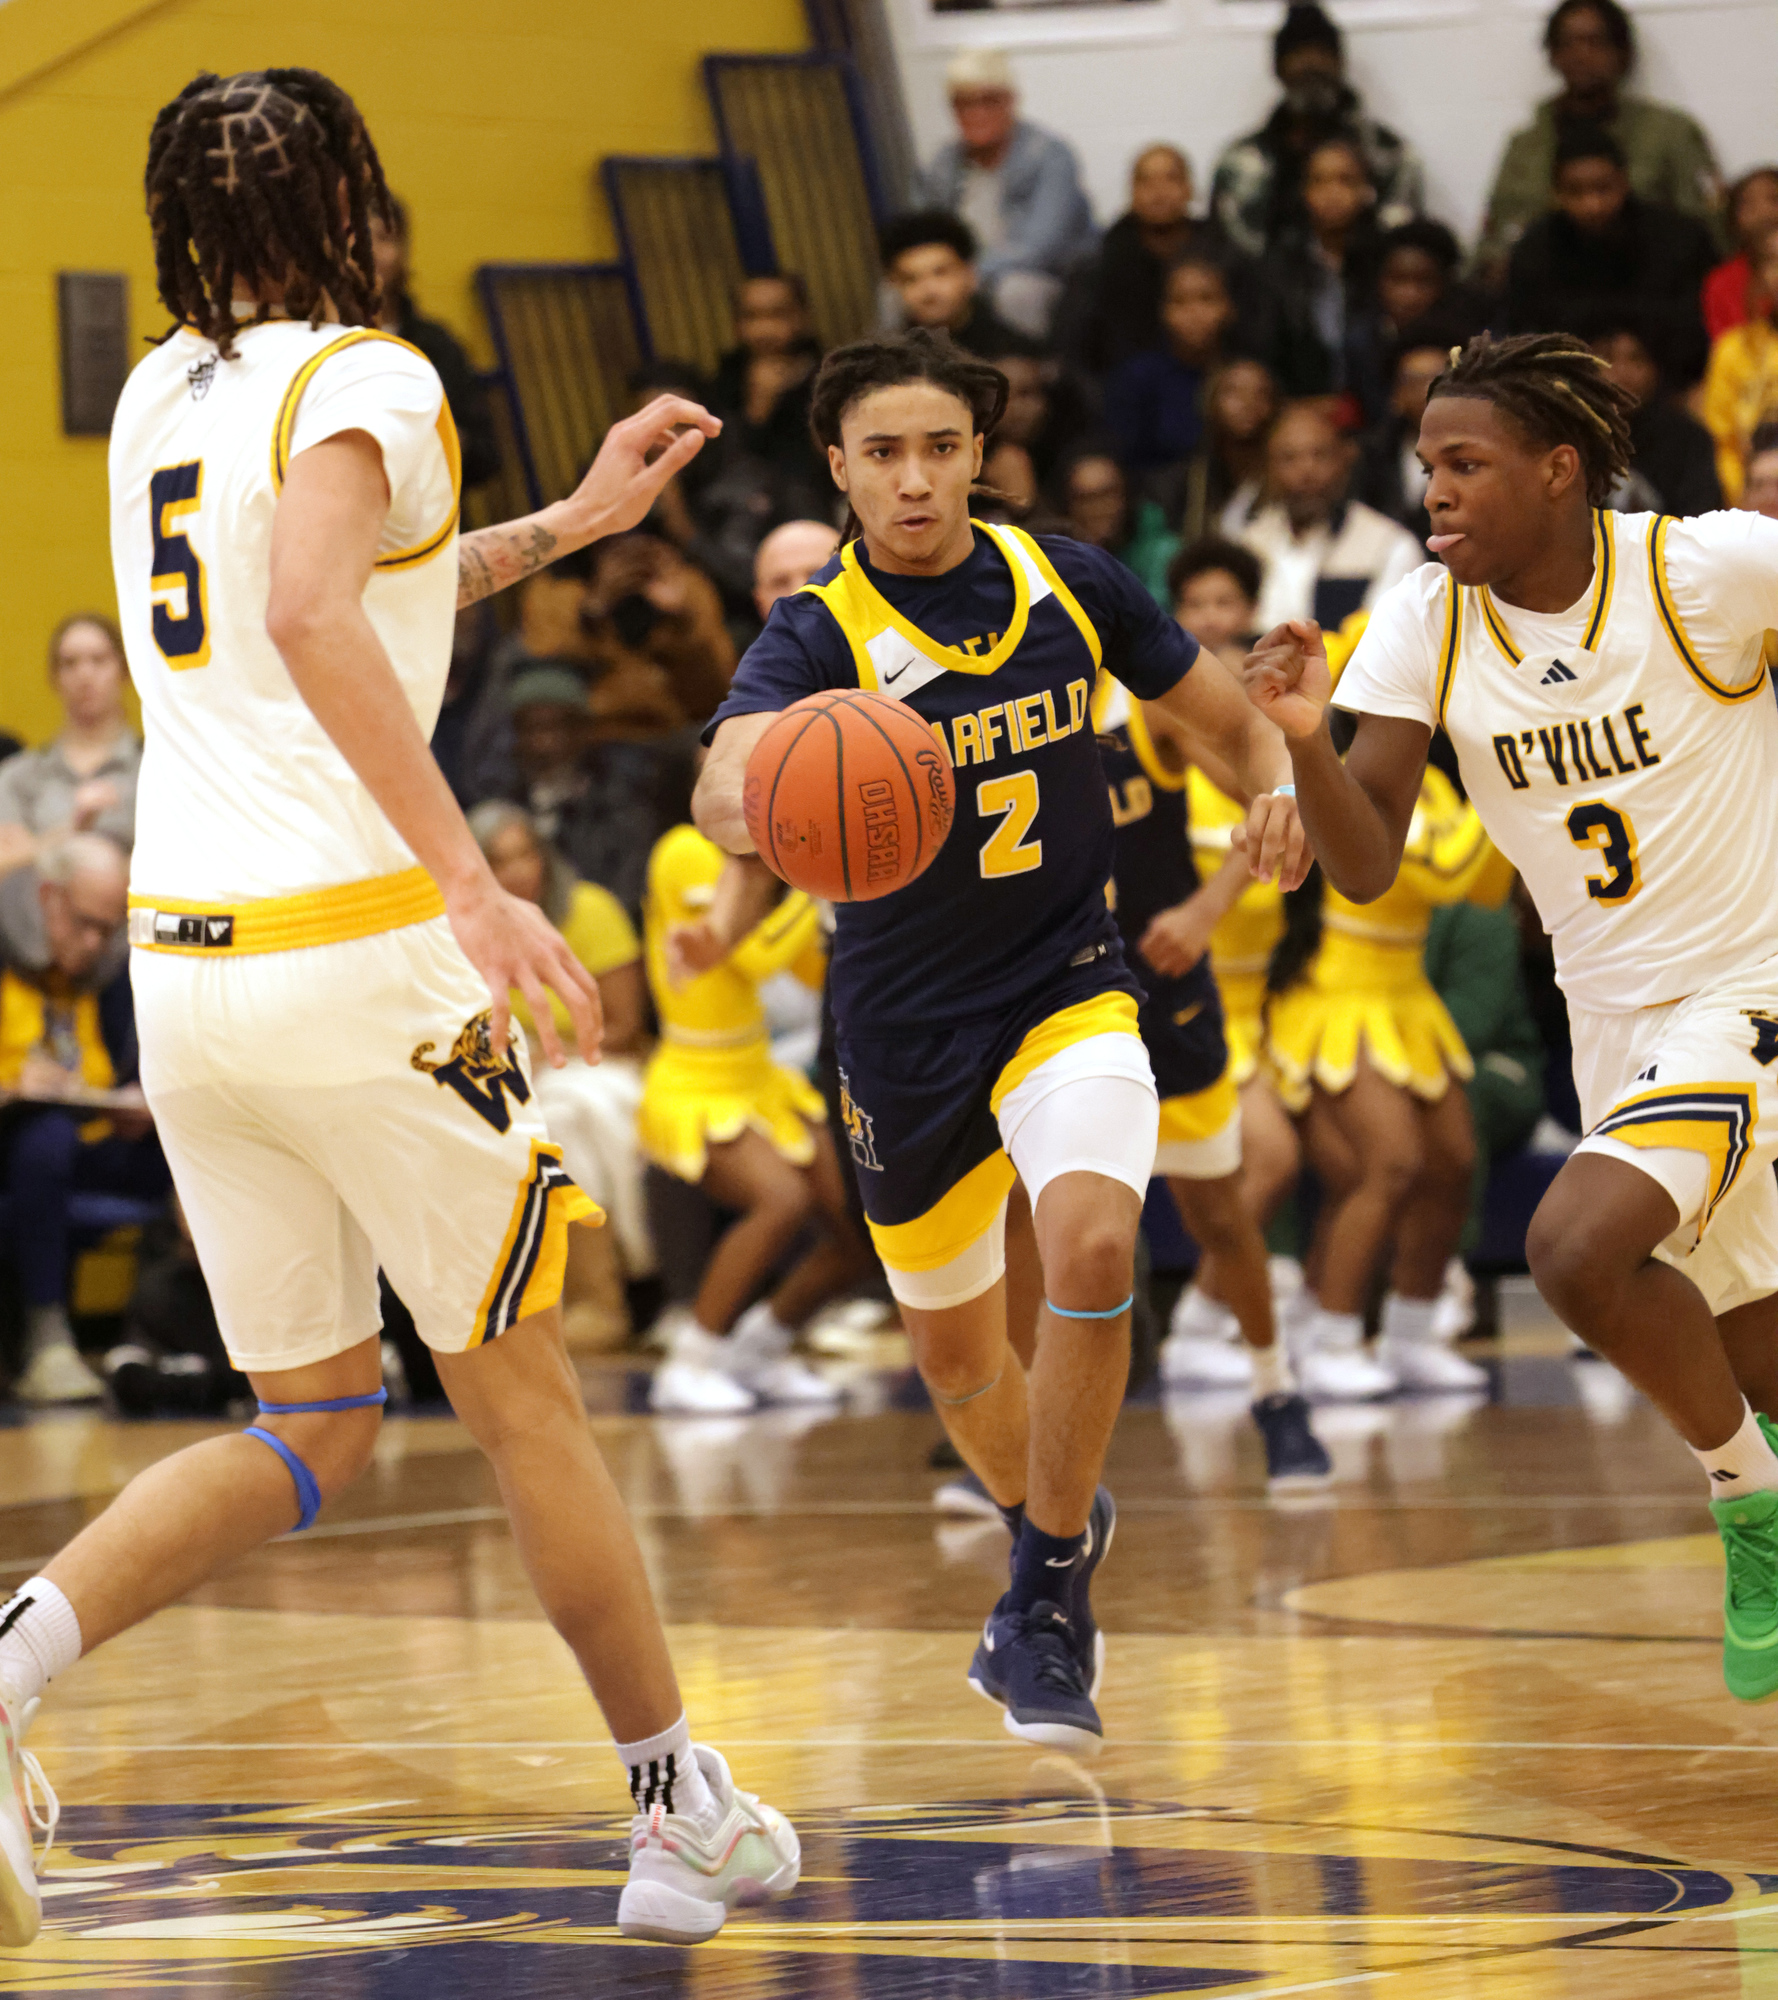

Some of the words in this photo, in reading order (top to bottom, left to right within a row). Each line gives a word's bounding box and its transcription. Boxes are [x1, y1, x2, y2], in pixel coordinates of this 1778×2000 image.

[149, 457, 212, 672] 5
[929, 677, 1088, 769] ARFIELD
[1492, 703, 1661, 790] D'VILLE
[858, 779, 900, 886] OHSAA
[976, 769, 1042, 879] 2
[1564, 797, 1644, 909] 3
[431, 1043, 531, 1136] W
